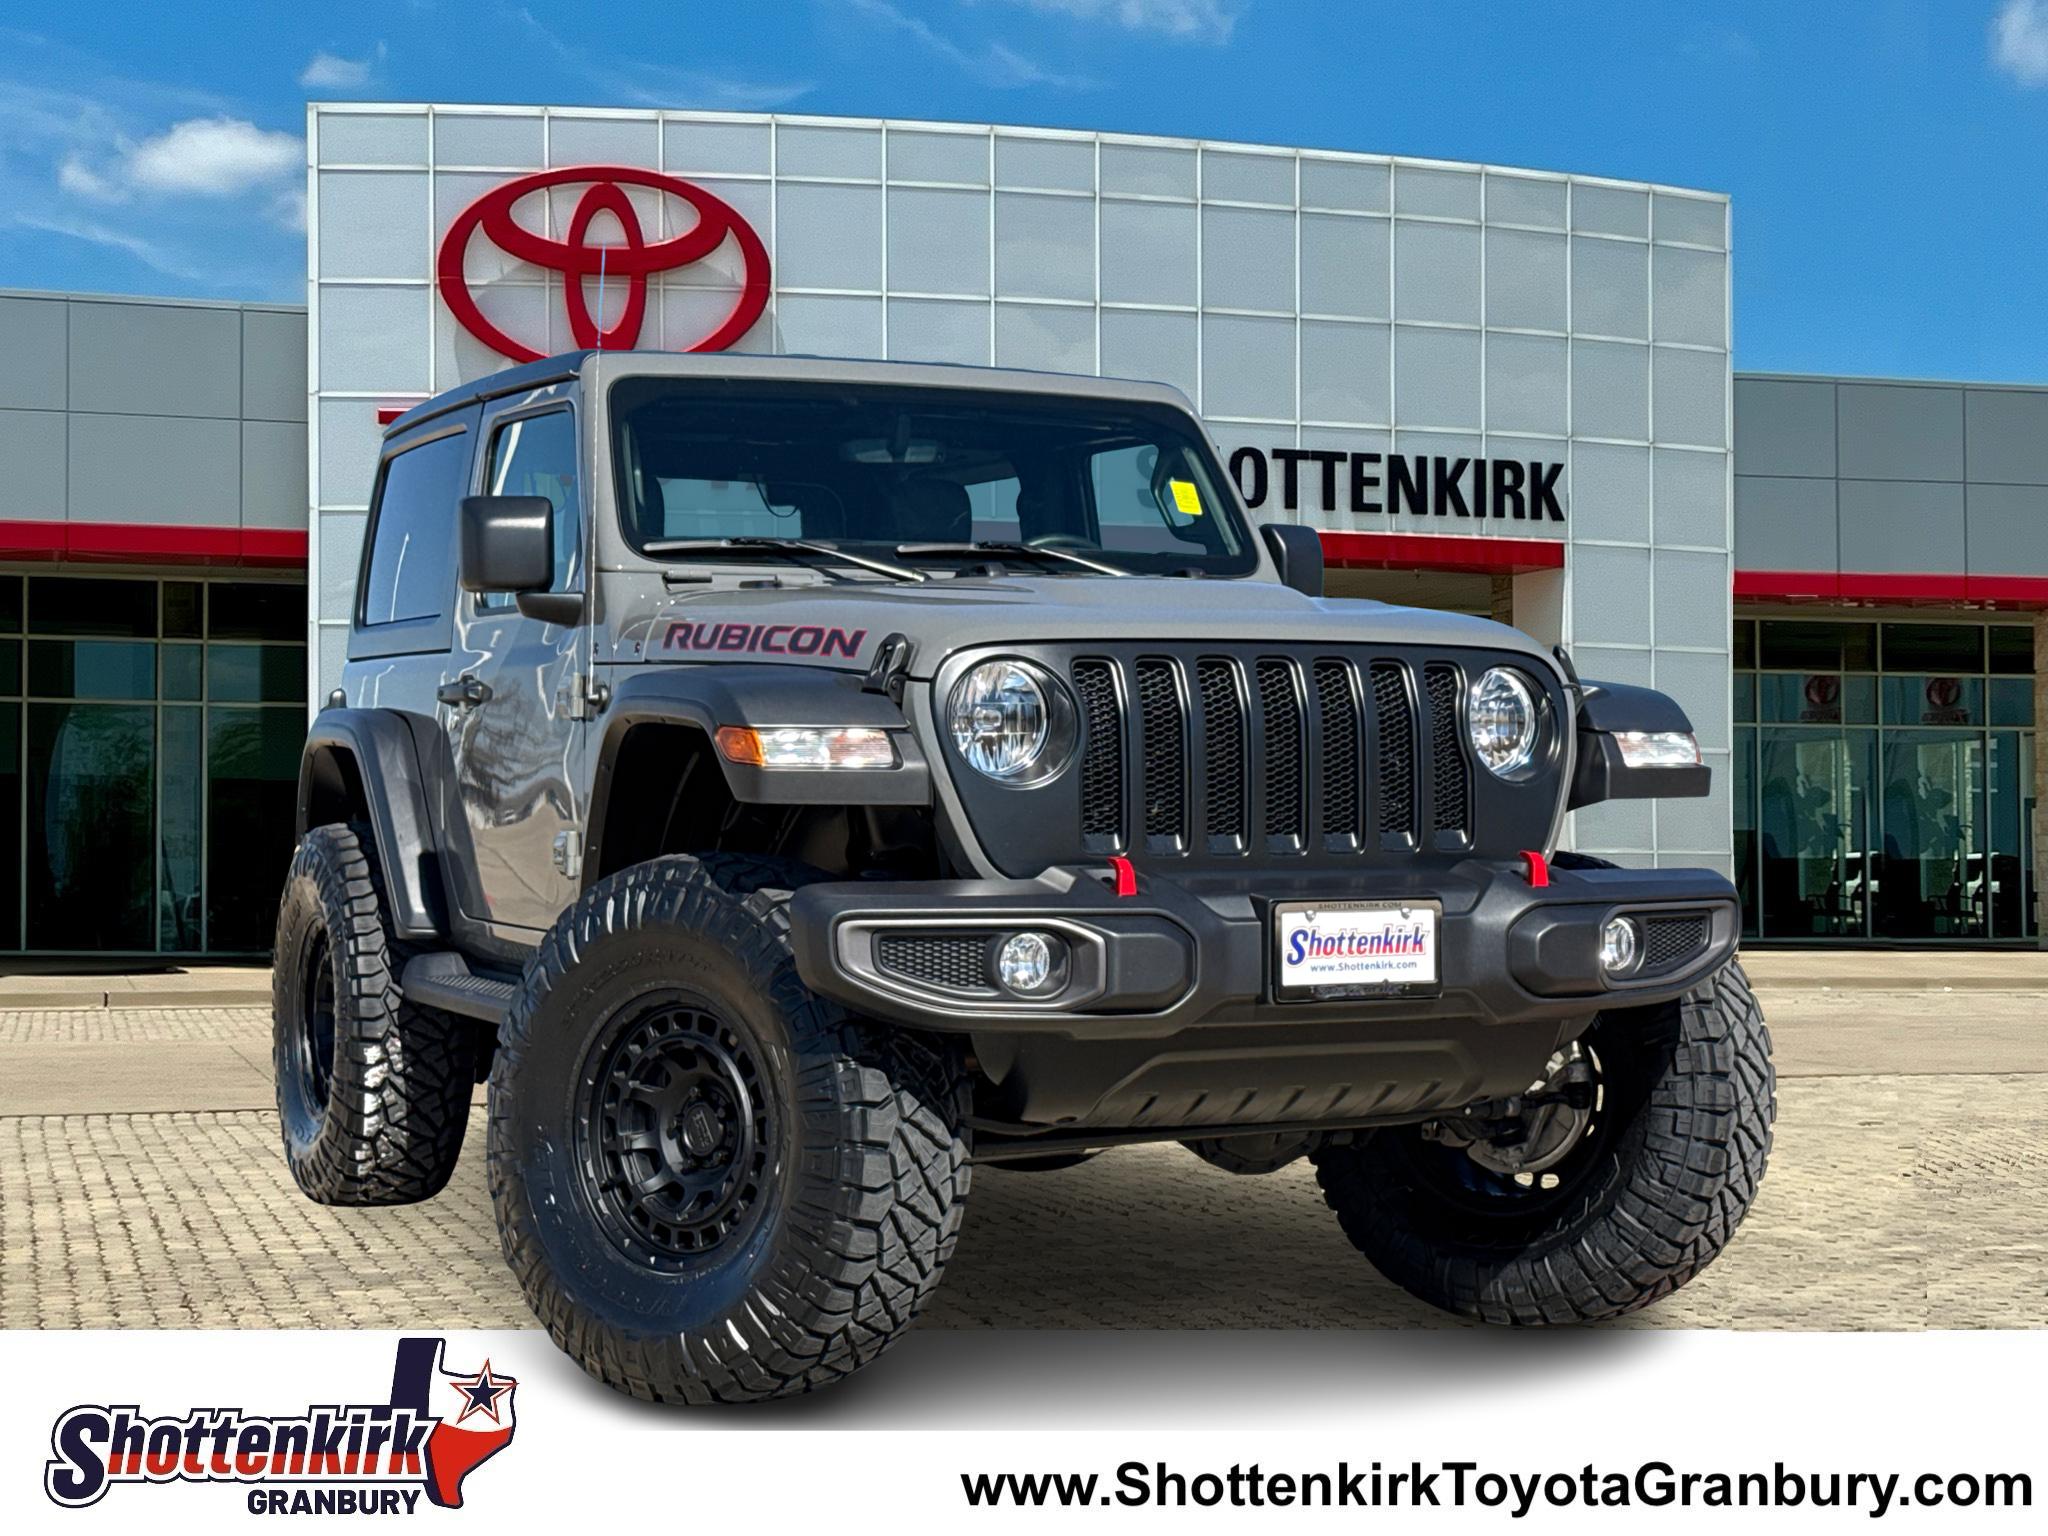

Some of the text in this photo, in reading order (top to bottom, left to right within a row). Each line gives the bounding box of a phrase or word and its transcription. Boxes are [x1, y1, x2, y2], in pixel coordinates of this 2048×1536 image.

[662, 622, 867, 658] RUBICON
[1286, 923, 1426, 966] Shottenkirk
[1310, 960, 1417, 972] www.Shottenkirk.com
